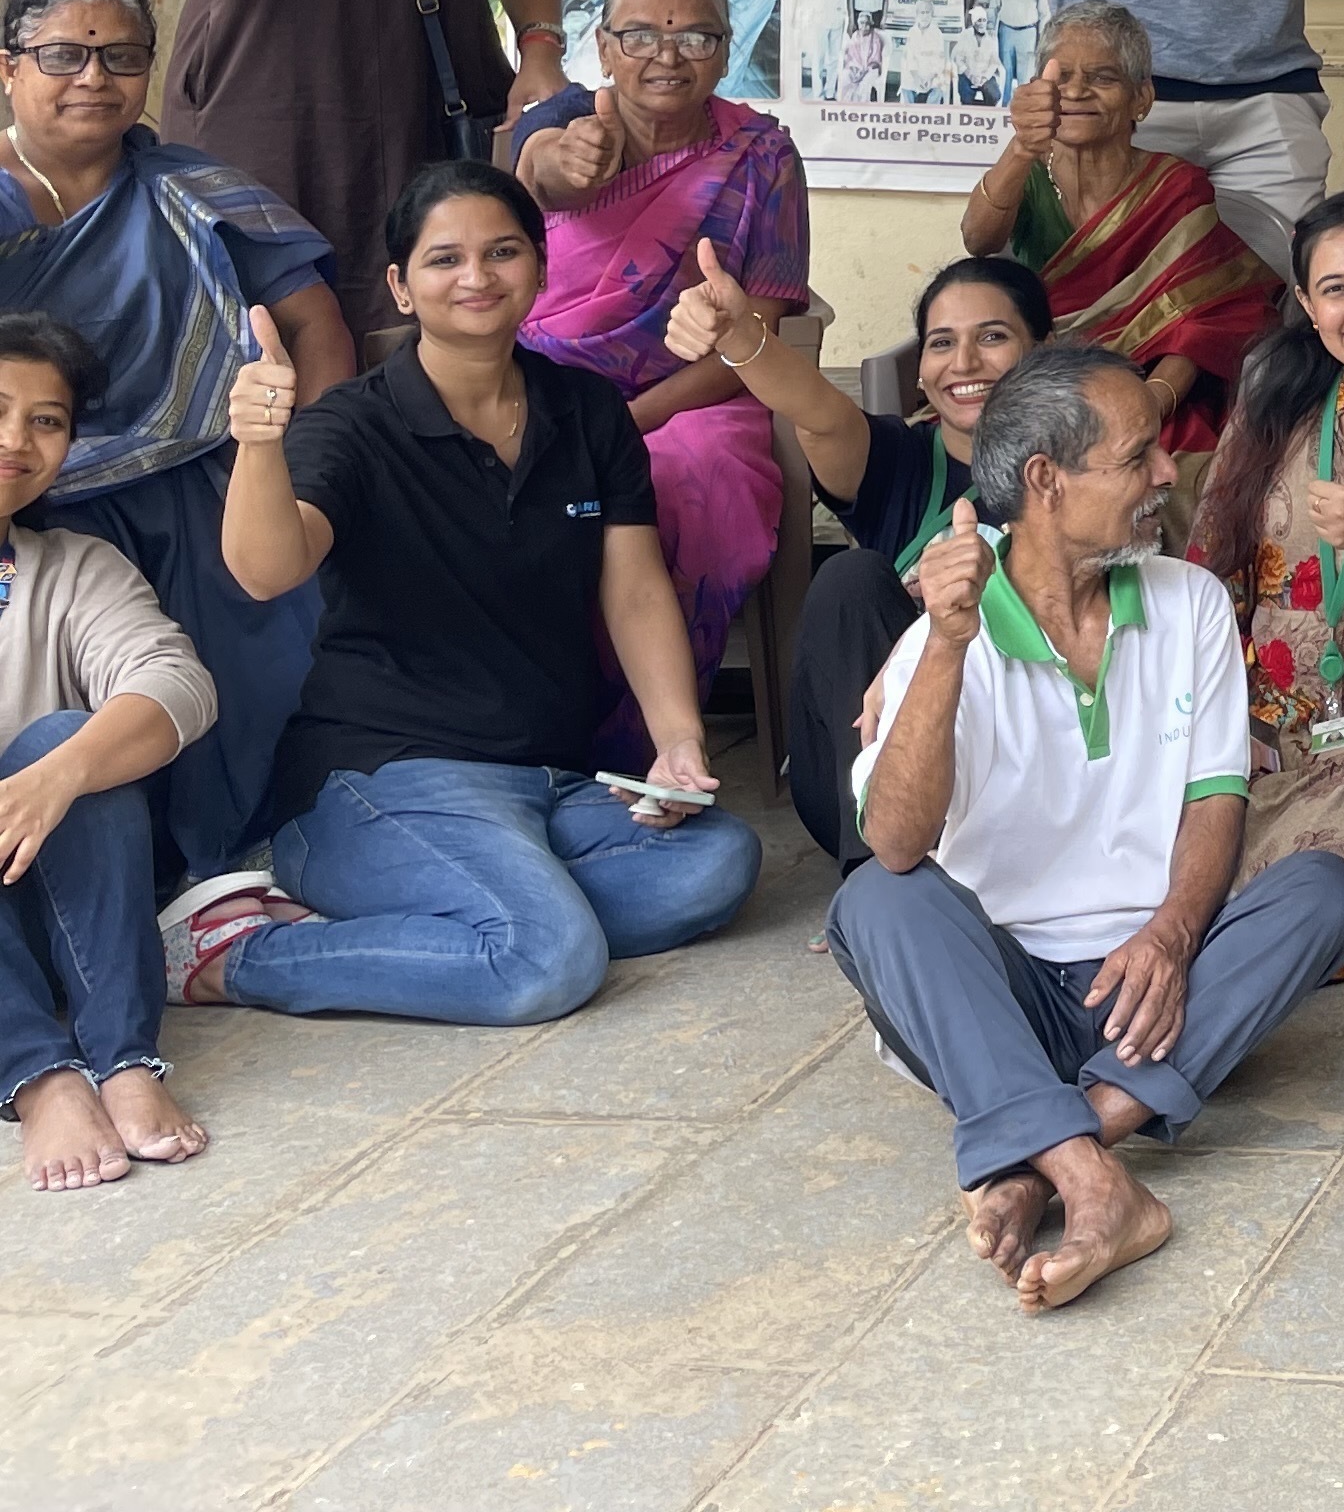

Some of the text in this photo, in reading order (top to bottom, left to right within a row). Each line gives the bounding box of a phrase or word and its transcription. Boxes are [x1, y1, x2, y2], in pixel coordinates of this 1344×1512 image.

[820, 110, 952, 127] International
[958, 113, 997, 130] Day
[856, 127, 999, 146] Older Persons
